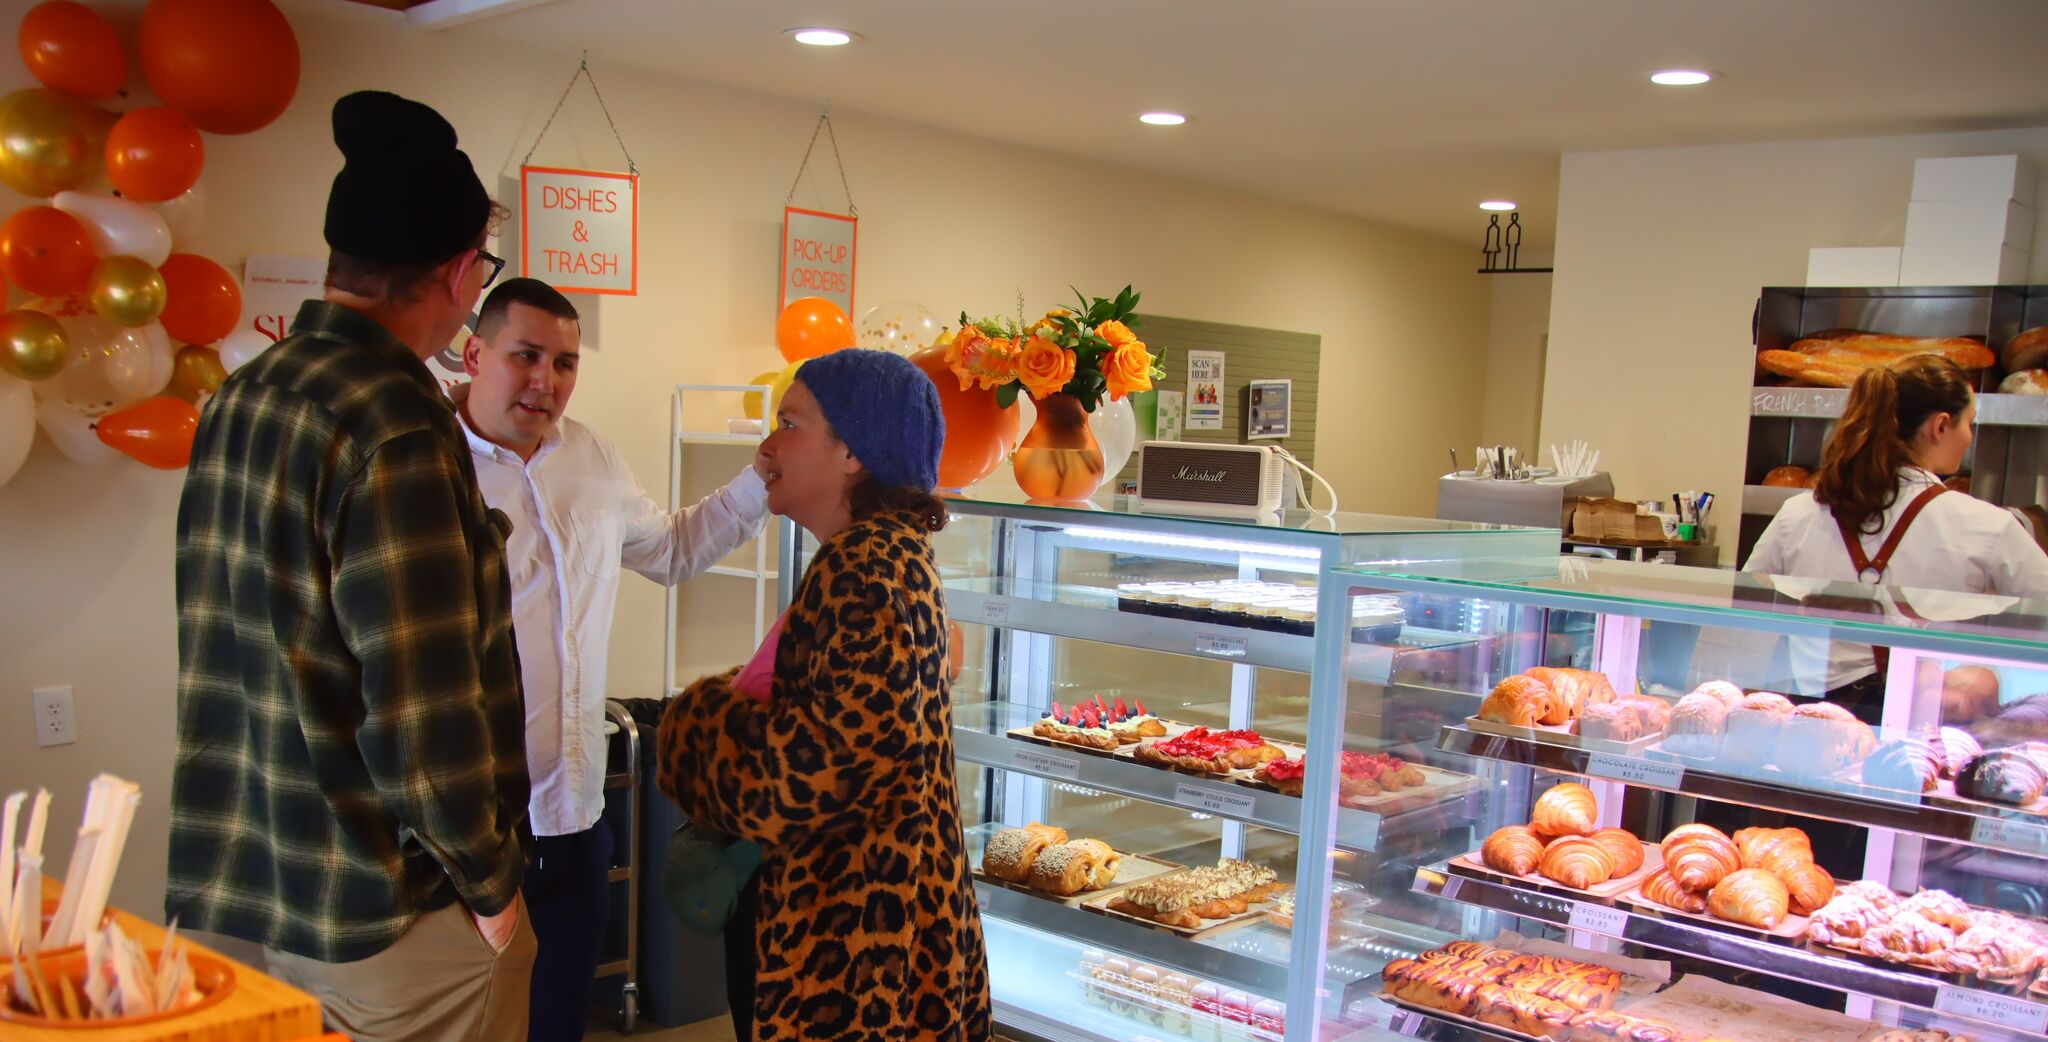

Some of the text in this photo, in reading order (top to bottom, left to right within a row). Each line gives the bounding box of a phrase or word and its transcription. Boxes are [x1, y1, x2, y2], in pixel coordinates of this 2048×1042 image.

[543, 185, 617, 213] DISHES
[572, 219, 588, 242] &
[793, 238, 848, 264] PICK-UP
[543, 248, 618, 276] TRASH
[792, 267, 848, 293] ORDERS
[1191, 359, 1210, 369] SCAN
[1191, 369, 1209, 379] HERE
[1172, 465, 1227, 482] Marshall
[1050, 760, 1077, 769] CROISSANT
[1592, 758, 1680, 776] CHOCOLATE CROISSANT
[1224, 797, 1250, 807] CROISSANT
[1576, 906, 1623, 922] CROISSANT
[1945, 990, 2041, 1017] ALMOND CROISSANT
